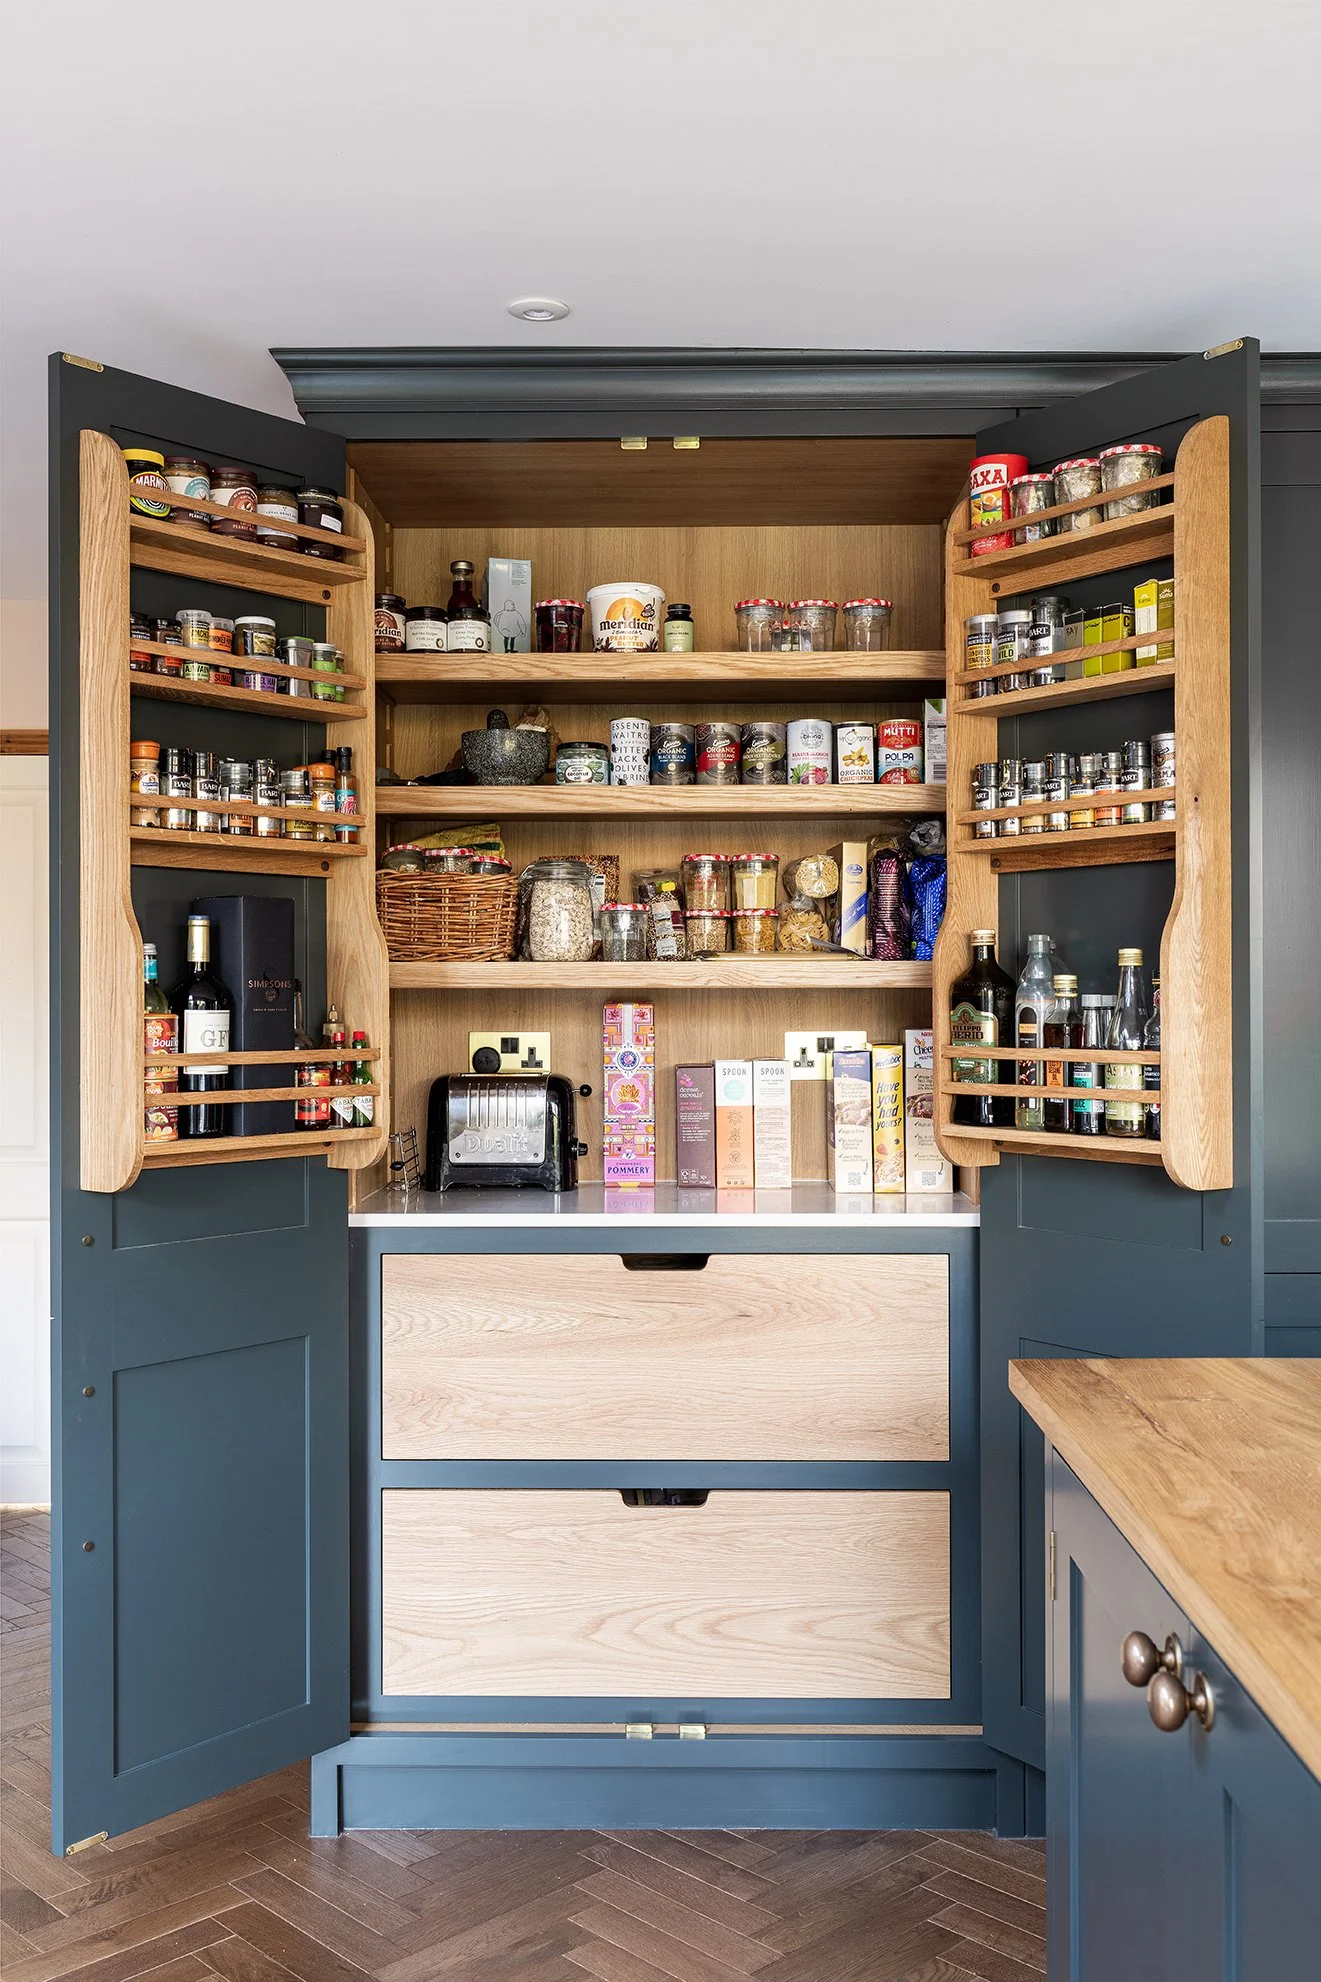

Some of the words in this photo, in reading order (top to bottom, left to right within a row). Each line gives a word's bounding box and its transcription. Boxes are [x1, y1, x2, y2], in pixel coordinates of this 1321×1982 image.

[135, 475, 168, 491] MARMIT
[600, 618, 654, 632] meridian
[374, 627, 402, 637] ridian
[884, 727, 915, 737] MUTTI
[615, 746, 647, 754] PITTED
[657, 747, 687, 755] ORGANIC
[706, 746, 736, 754] ORGANIC
[746, 746, 776, 754] ORGANIC
[885, 752, 915, 761] POLPA
[615, 764, 647, 773] OLIVES
[622, 774, 649, 782] BRINE
[248, 979, 292, 988] SIMPSONS
[723, 1067, 747, 1076] SPOON
[760, 1067, 785, 1076] SPOON
[876, 1082, 900, 1094] Have
[877, 1094, 898, 1109] you
[878, 1105, 900, 1119] had
[875, 1117, 902, 1131] yours?
[465, 1134, 528, 1154] Dualit
[607, 1166, 650, 1174] POMMERY
